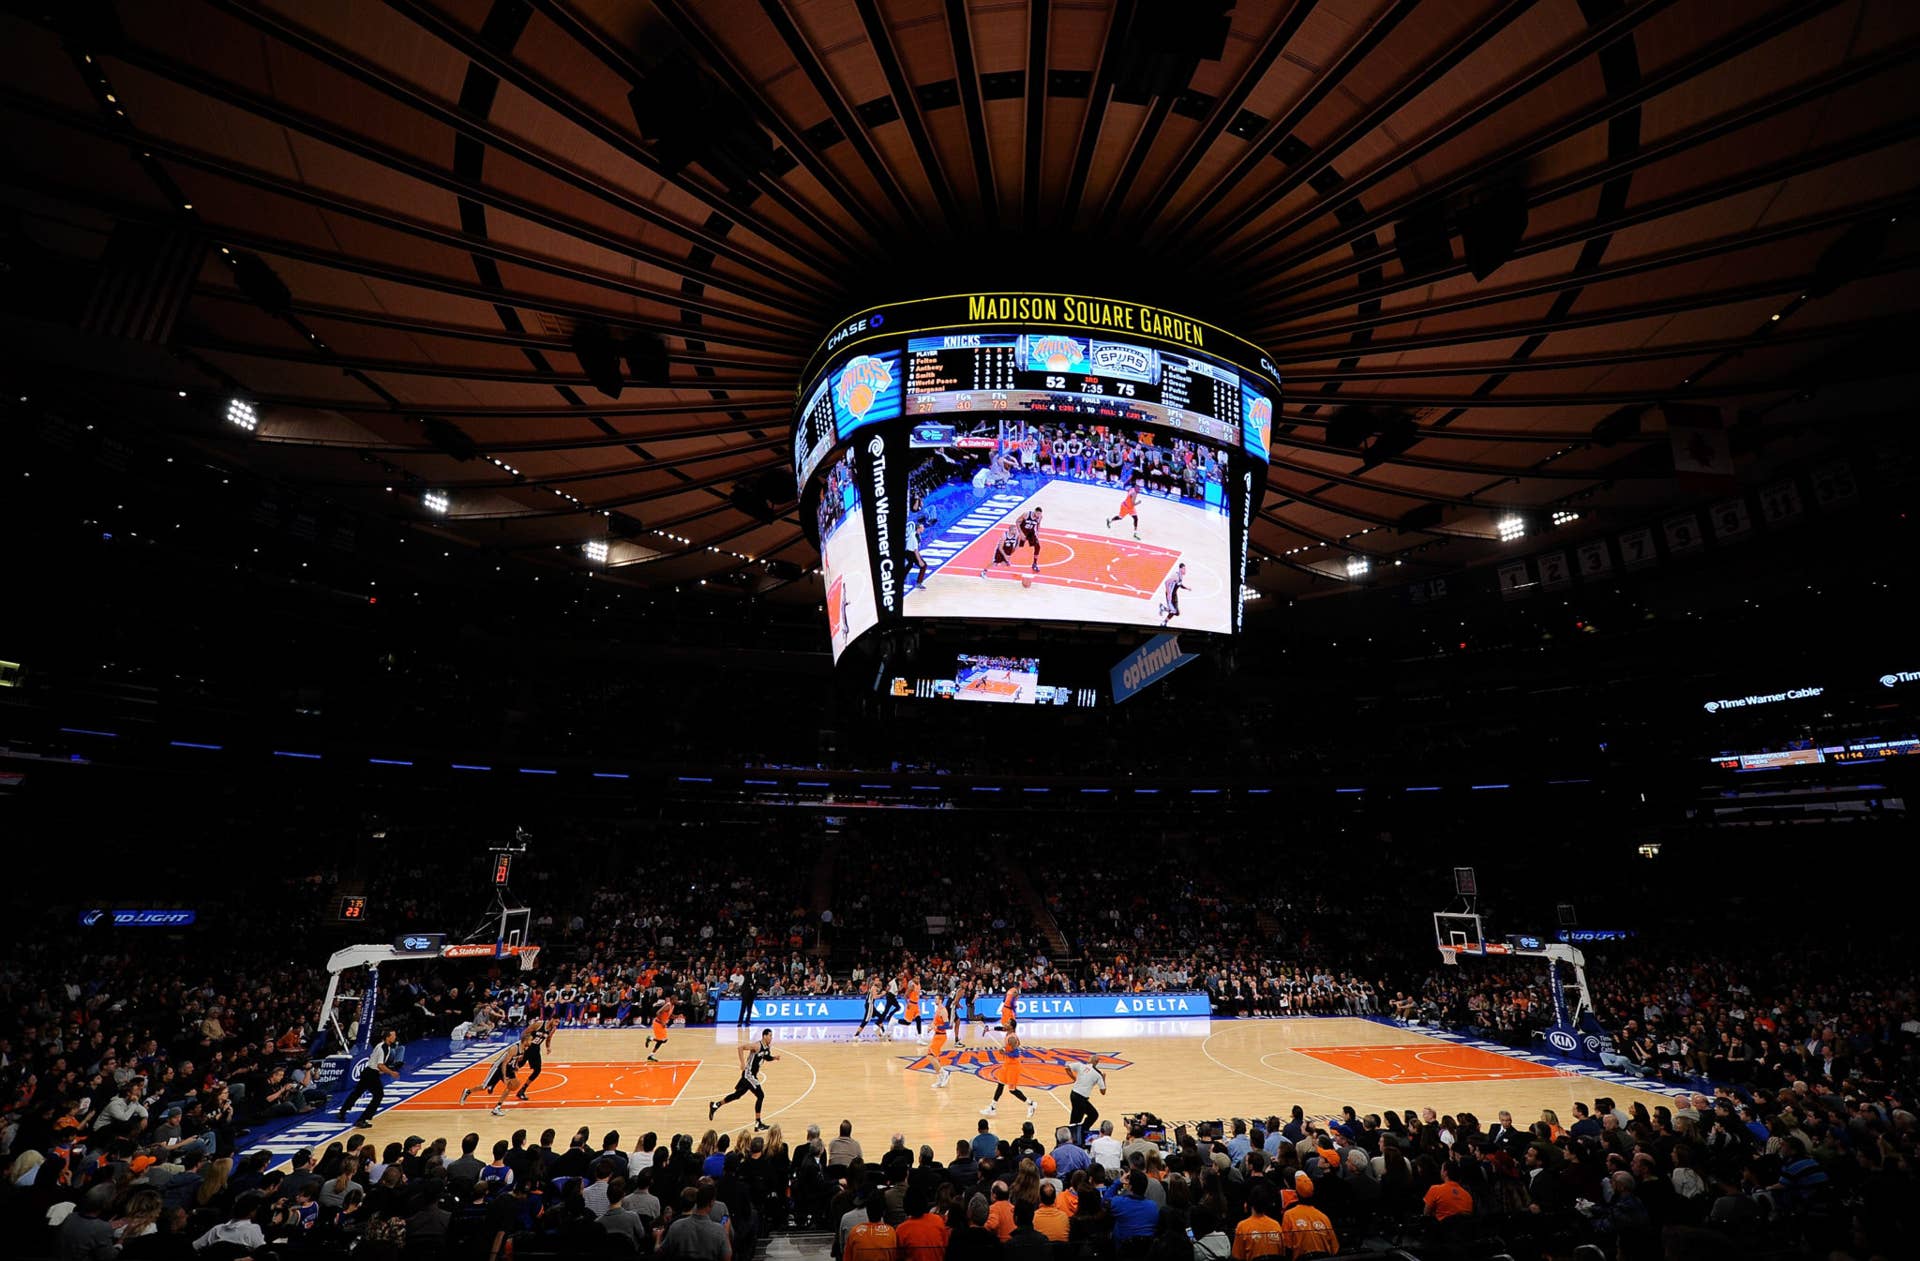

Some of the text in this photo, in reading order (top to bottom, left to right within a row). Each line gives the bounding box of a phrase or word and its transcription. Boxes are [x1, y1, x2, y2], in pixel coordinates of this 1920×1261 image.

[969, 296, 1204, 347] MADISON SQUARE GARDEN
[828, 319, 867, 350] CHASE
[944, 335, 980, 348] KNICKS
[1101, 353, 1143, 369] SPURS
[1188, 359, 1213, 376] SPURS
[839, 360, 889, 404] KNICKS
[1046, 376, 1066, 389] 52
[1081, 383, 1103, 394] 7:35
[1116, 383, 1135, 396] 75
[945, 494, 1026, 535] KNICKS
[872, 455, 896, 607] Time Warner Cable
[1718, 687, 1821, 710] Time Warner Cable
[345, 906, 360, 917] 23
[765, 1002, 829, 1017] DELTA
[1016, 1000, 1074, 1014] DELTA
[1132, 998, 1189, 1013] DELTA
[1553, 1034, 1573, 1048] KIA
[237, 1121, 354, 1156] NEW
[411, 1042, 510, 1076] KNICKS
